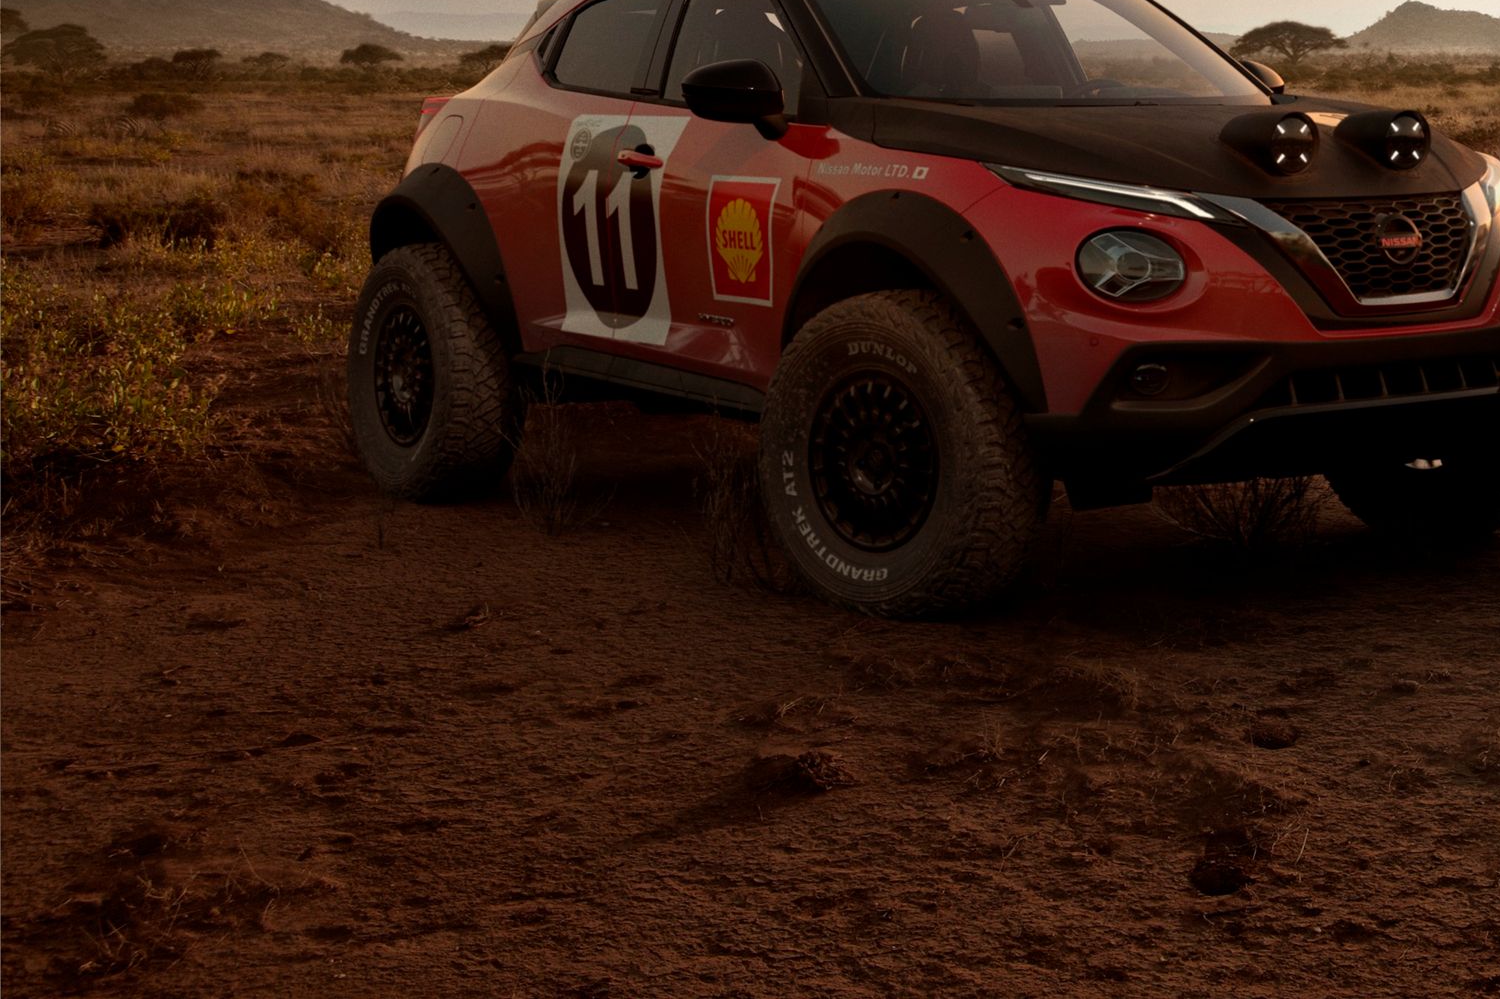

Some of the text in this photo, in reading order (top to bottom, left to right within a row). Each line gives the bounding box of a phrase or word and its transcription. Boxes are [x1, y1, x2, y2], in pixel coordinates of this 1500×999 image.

[817, 162, 910, 178] Nissan Motor LTD.
[573, 169, 639, 290] 11
[722, 230, 757, 250] SHELL
[1381, 235, 1418, 247] NISSAN
[847, 341, 918, 374] DUNLOP
[792, 506, 889, 582] GRANDTREK
